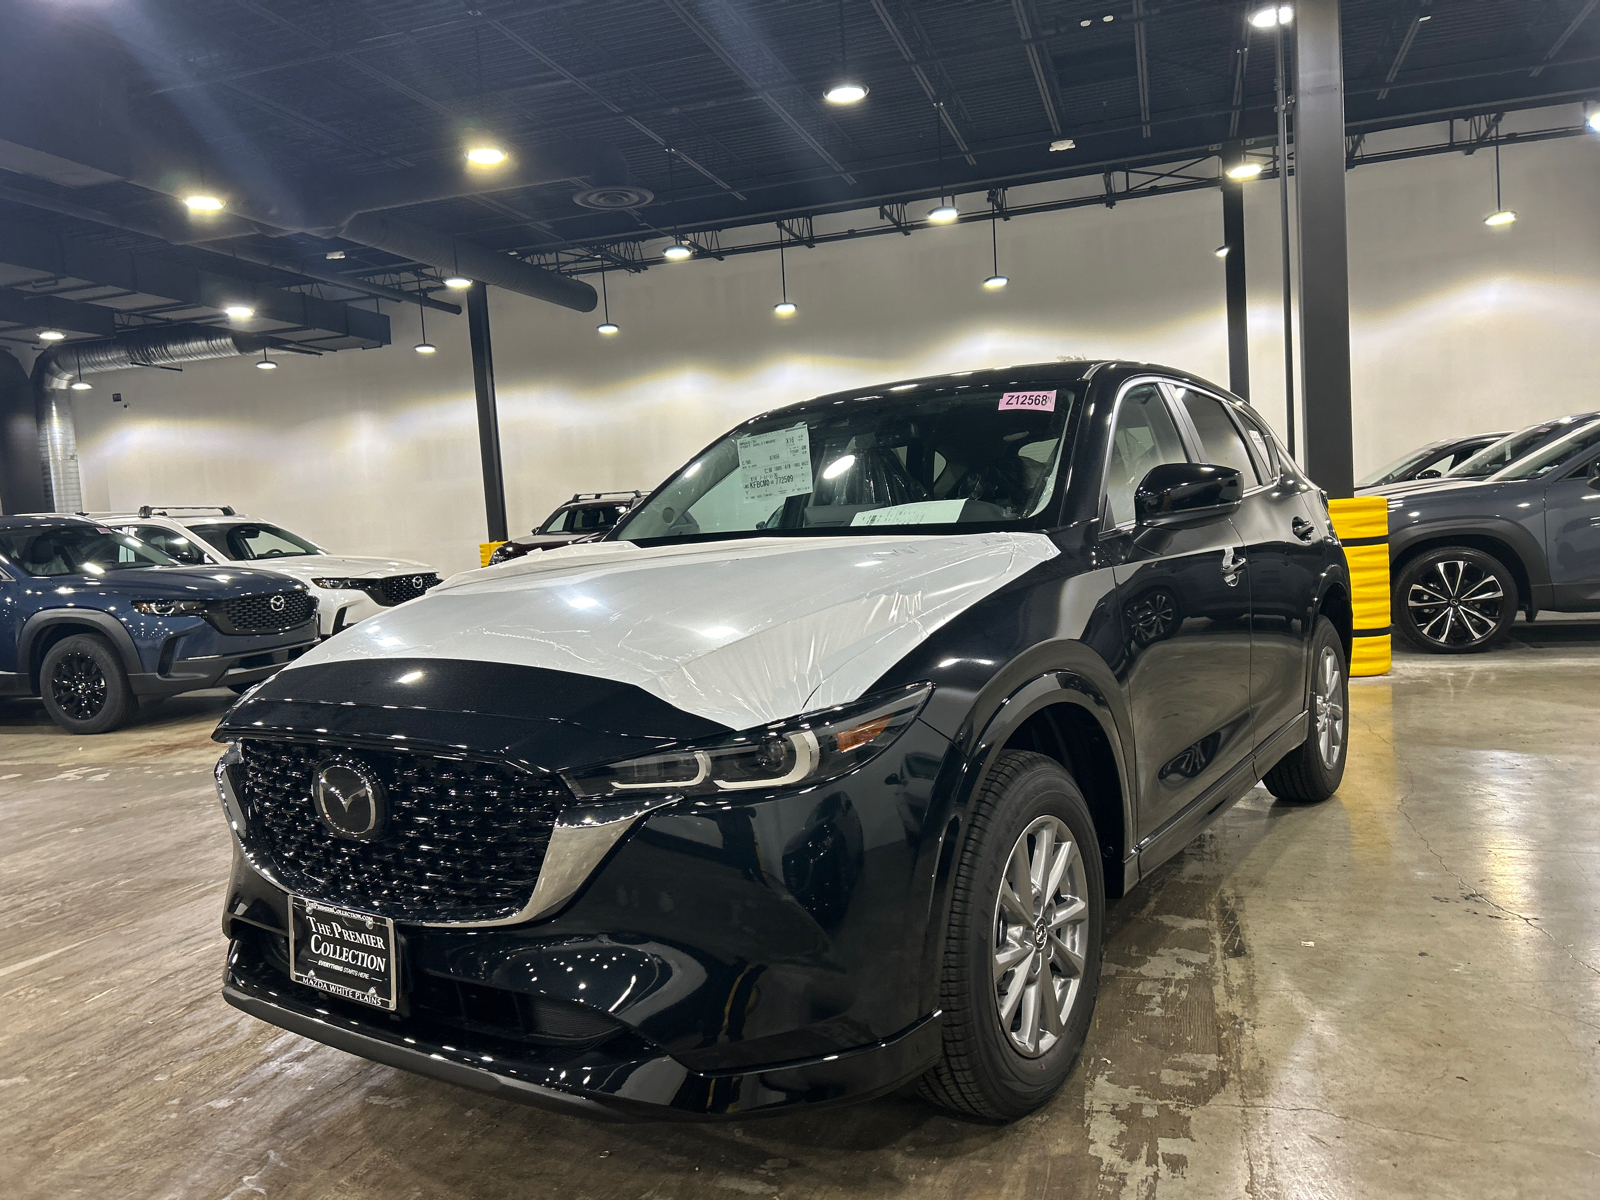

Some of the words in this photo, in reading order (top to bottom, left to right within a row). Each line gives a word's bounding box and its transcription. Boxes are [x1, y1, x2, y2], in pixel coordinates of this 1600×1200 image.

[1005, 394, 1048, 406] Z12568
[306, 915, 333, 937] THE
[331, 921, 386, 950] PREMIER
[310, 934, 386, 973] COLLECTION
[302, 977, 328, 990] MAZDA
[329, 985, 353, 998] WHITE
